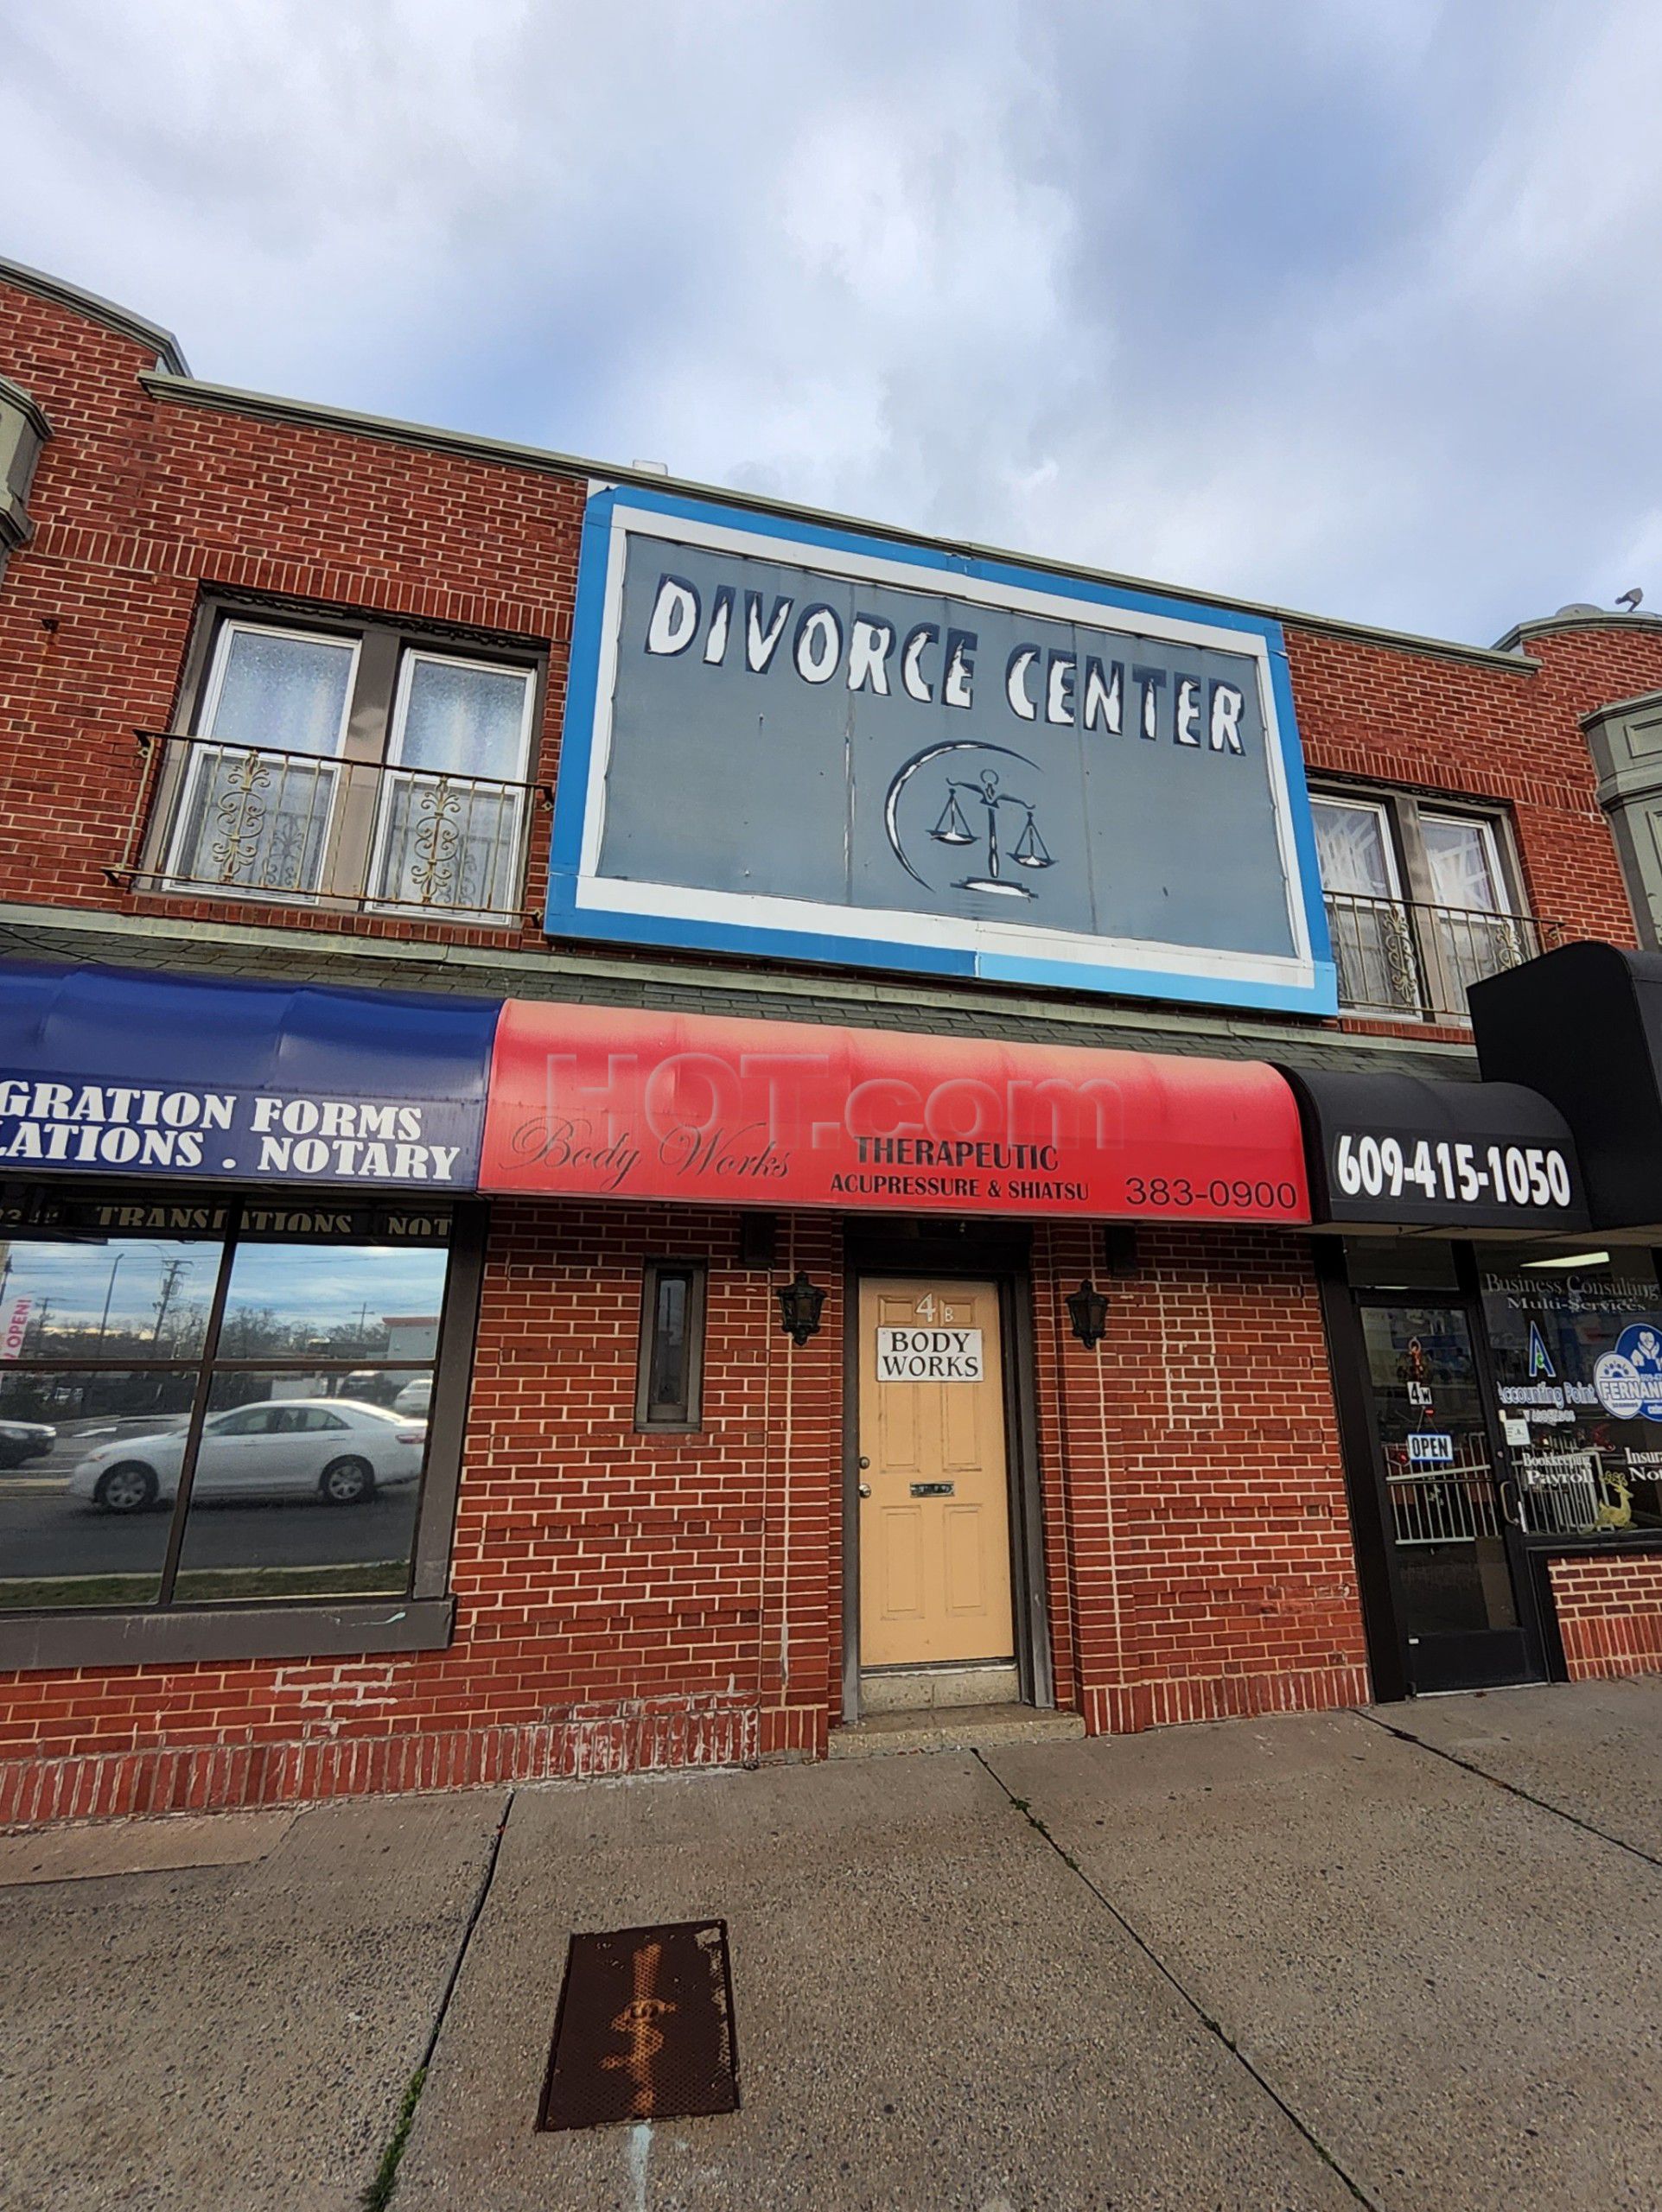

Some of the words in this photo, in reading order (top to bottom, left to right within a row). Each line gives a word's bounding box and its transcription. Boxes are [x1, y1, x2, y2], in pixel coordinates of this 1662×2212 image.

[646, 573, 978, 710] DIVORCE
[1004, 641, 1247, 757] CENTER
[250, 1096, 423, 1141] FORMS
[257, 1135, 461, 1180] NOTARY
[499, 1116, 642, 1192] Body
[659, 1122, 792, 1179] Works
[854, 1135, 1059, 1172] THERAPEUTIC
[1339, 1135, 1570, 1206] 609-415-1050
[830, 1173, 981, 1198] ACUPRESSURE
[987, 1179, 1001, 1198] &
[1008, 1180, 1089, 1201] SHIATSU
[1125, 1178, 1296, 1210] 383-0900
[1486, 1273, 1562, 1294] Business
[1566, 1274, 1659, 1300] Consulting
[890, 1332, 971, 1353] BODY
[882, 1356, 978, 1377] WORKS
[1411, 1437, 1449, 1458] OPEN
[1522, 1452, 1592, 1468] Bookkeeping
[1525, 1468, 1594, 1487] Payroll
